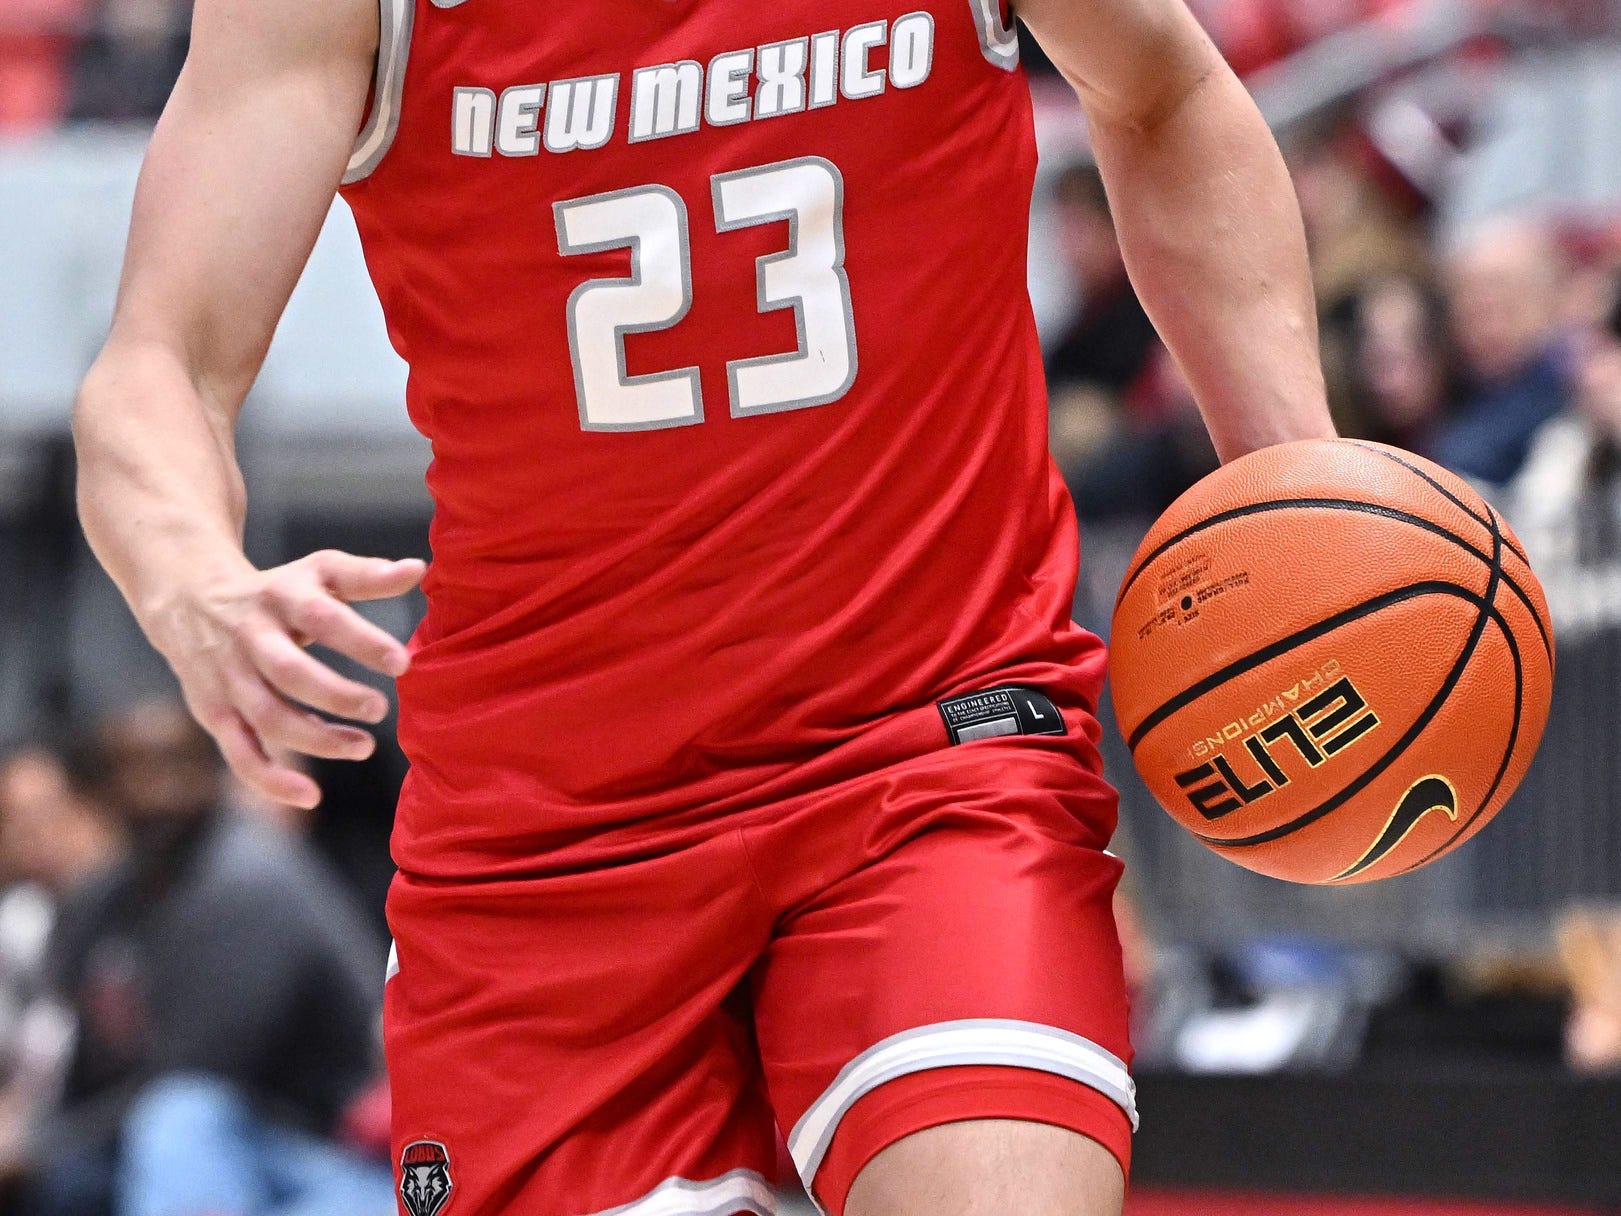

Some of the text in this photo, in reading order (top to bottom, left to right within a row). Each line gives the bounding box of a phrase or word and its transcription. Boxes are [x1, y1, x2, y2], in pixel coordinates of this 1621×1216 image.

[451, 11, 935, 157] NEW MEXICO
[551, 155, 858, 432] 23
[947, 693, 1008, 714] ENGINEERED
[1027, 700, 1044, 720] L
[1174, 674, 1381, 821] ELITE
